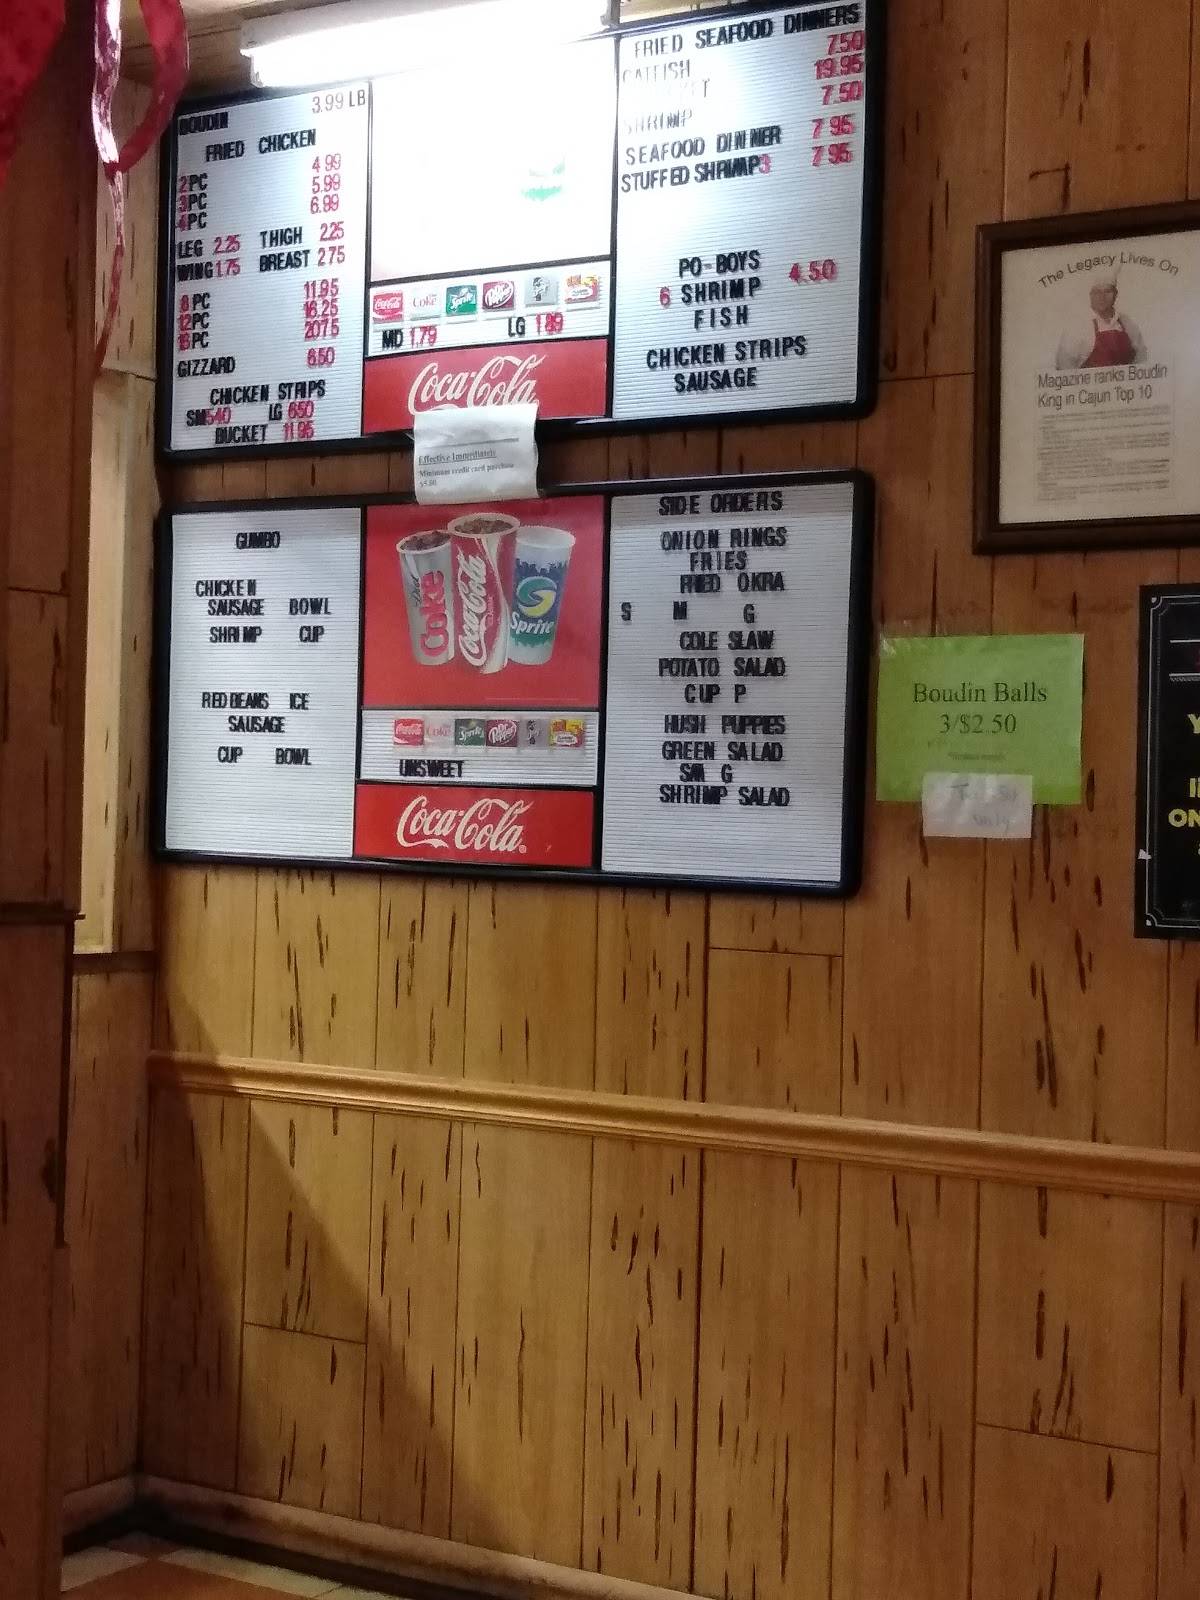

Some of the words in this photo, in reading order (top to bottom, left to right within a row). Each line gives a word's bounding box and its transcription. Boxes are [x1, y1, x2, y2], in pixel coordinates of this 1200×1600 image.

[635, 34, 683, 58] FRIED
[695, 18, 774, 49] SEAFOOD
[784, 3, 860, 35] DINNERS
[312, 96, 344, 114] 3.99
[349, 90, 366, 107] LB
[205, 140, 245, 162] FRIED
[259, 128, 316, 154] CHICKEN
[626, 136, 705, 166] SEAFOOD
[716, 125, 782, 154] DINNER
[621, 165, 690, 193] STUFFED
[177, 240, 203, 259] LEG
[260, 226, 303, 249] THIGH
[177, 261, 213, 282] WING
[259, 249, 310, 273] BREAST
[679, 250, 761, 278] PO-BOYS
[1038, 270, 1064, 288] The
[1067, 254, 1116, 274] Legacy
[1120, 252, 1155, 267] Lives
[1159, 259, 1179, 276] On
[659, 286, 671, 307] 6
[681, 276, 762, 305] SHRIMP
[694, 305, 749, 329] FISH
[382, 329, 403, 349] MD
[508, 317, 525, 337] LG
[646, 343, 725, 370] CHICKEN
[734, 335, 808, 362] STRIPS
[177, 356, 236, 377] GIZZARD
[1038, 372, 1091, 390] Magazine
[1094, 369, 1124, 383] ranks
[1128, 363, 1167, 381] Boudin
[407, 354, 547, 416] Coca-Cola
[674, 367, 757, 393] SAUSAGE
[210, 384, 269, 405] CHICKEN
[278, 379, 326, 400] STRIPS
[1038, 393, 1062, 410] King
[1065, 394, 1075, 405] in
[1078, 390, 1111, 407] Cajun
[1114, 386, 1135, 404] Top
[1138, 384, 1152, 399] 10
[269, 403, 283, 421] LG
[215, 423, 268, 444] BUCKET
[418, 454, 450, 466] Effective
[452, 448, 497, 462] Immediately
[659, 495, 699, 516] SIDE
[710, 491, 783, 513] ORDERS
[236, 531, 281, 550] GUMBO
[660, 529, 719, 551] ONION
[730, 526, 788, 548] RINGS
[690, 550, 748, 572] FRIES
[195, 579, 257, 597] CHICKEN
[737, 571, 786, 593] OKRA
[208, 599, 264, 616] SAUSAGE
[289, 598, 331, 615] BOWL
[621, 601, 632, 622] S
[672, 601, 688, 621] M
[743, 604, 755, 624] G
[209, 626, 263, 643] SHRIMP
[299, 625, 325, 643] CUP
[510, 611, 555, 635] Sprite
[679, 630, 718, 651] COLE
[728, 630, 775, 650] SLAW
[658, 658, 720, 677] POTATO
[733, 656, 786, 677] SALAD
[684, 684, 721, 704] CUP
[734, 684, 747, 703] P
[912, 682, 986, 703] Boudin
[994, 682, 1048, 703] Balls
[228, 716, 286, 733] SAUSAGE
[664, 714, 706, 734] HUSH
[721, 715, 786, 735] PUPPIES
[939, 713, 1017, 735] 3/$2.50
[217, 746, 243, 763] CUP
[275, 748, 312, 765] BOWL
[661, 740, 715, 761] GREEN
[727, 741, 784, 762] SALAD
[399, 759, 464, 778] UNSWEET
[720, 763, 734, 784] G
[659, 784, 728, 805] SHRIMP
[738, 786, 791, 806] SALAD
[396, 794, 534, 852] Coca-Cola
